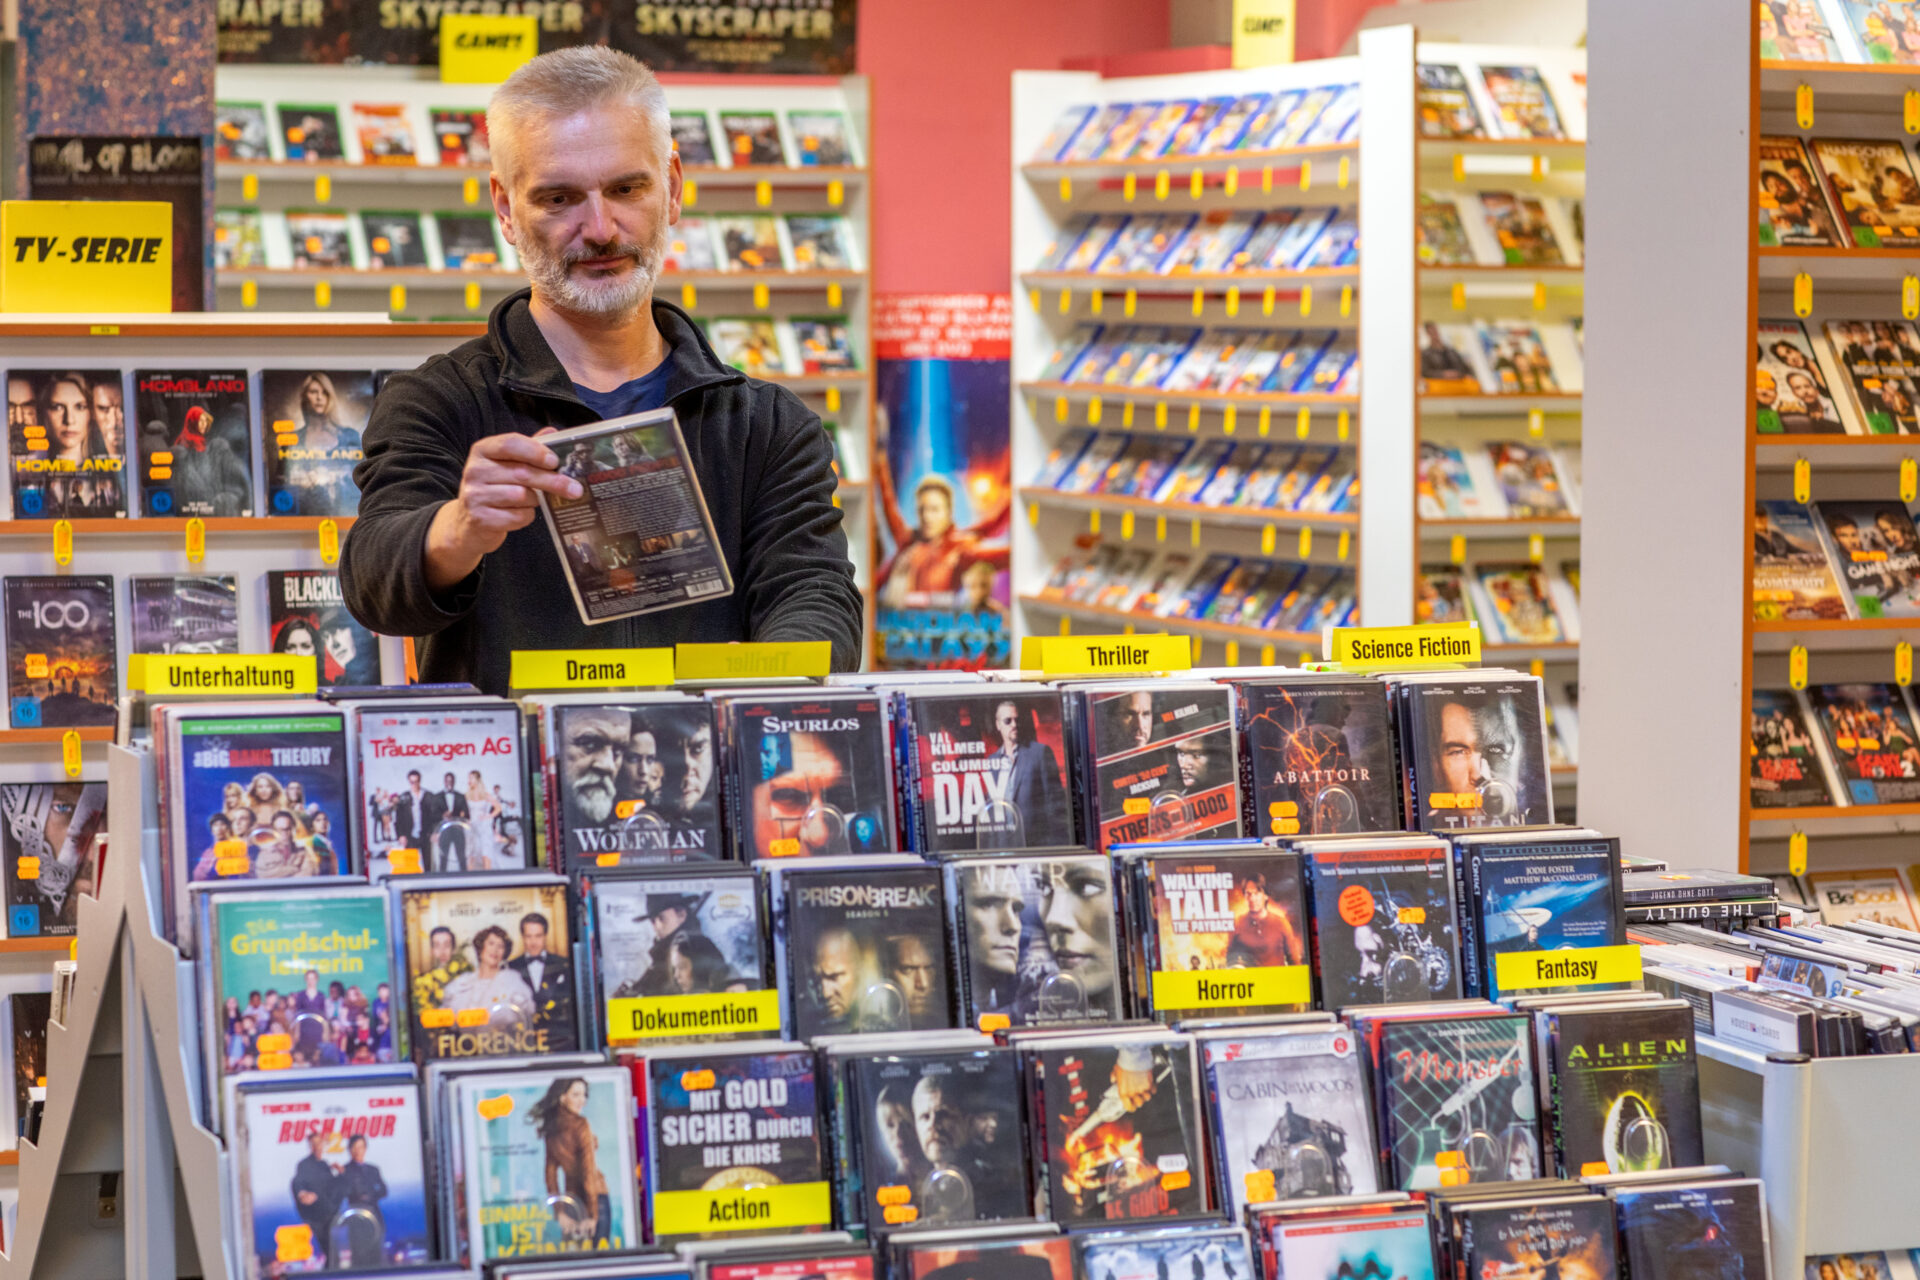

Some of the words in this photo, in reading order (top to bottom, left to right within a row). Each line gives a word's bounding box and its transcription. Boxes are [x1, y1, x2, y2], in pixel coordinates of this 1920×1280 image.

[635, 5, 834, 39] SKYSCRAPER
[14, 236, 163, 264] TV-SERIE
[140, 380, 245, 392] HOMELAND
[16, 458, 122, 473] HOMELAND
[278, 450, 364, 460] HOMELAND
[17, 610, 32, 620] THE
[32, 600, 90, 629] 100
[1086, 646, 1150, 666] Thriller
[1351, 638, 1414, 662] Science
[1418, 635, 1472, 659] Fiction
[169, 666, 295, 689] Unterhaltung
[566, 660, 626, 681] Drama
[762, 716, 861, 733] SPURLOS
[369, 738, 476, 761] Trauzeugen
[481, 736, 513, 756] AG
[929, 732, 950, 745] VAL
[930, 741, 986, 756] KILMER
[272, 746, 332, 767] THEORY
[931, 757, 1011, 773] COLUMBUS
[1273, 768, 1371, 784] ABATTOIR
[1899, 760, 1916, 778] 2
[933, 770, 1011, 827] DAY
[1181, 793, 1229, 826] BLOOD
[573, 828, 706, 852] WOLFMAN
[1471, 856, 1481, 896] CONTACT
[1503, 876, 1541, 885] MATTHEW
[1526, 866, 1547, 875] JODIE
[1548, 865, 1575, 874] FOSTER
[1161, 872, 1234, 890] WALKING
[1165, 889, 1234, 920] TALL
[1650, 889, 1676, 900] JUGEND
[1678, 888, 1695, 898] OHNE
[1697, 888, 1714, 897] GOTT
[845, 910, 880, 919] SEASON
[1645, 907, 1711, 921] GUILTY
[1720, 905, 1754, 917] THE
[1173, 921, 1189, 933] THE
[1191, 919, 1235, 932] PAYBACK
[230, 928, 379, 956] Grundschul-
[269, 952, 364, 976] lehrerin
[1536, 960, 1598, 980] Fantasy
[1197, 979, 1255, 1001] Horror
[632, 1003, 759, 1032] Dokumention
[438, 1028, 550, 1058] FLORENCE
[1568, 1038, 1687, 1060] ALIEN
[1397, 1050, 1524, 1084] Monster
[688, 1089, 721, 1112] MIT
[725, 1077, 789, 1110] GOLD
[1226, 1080, 1289, 1101] CABIN
[262, 1102, 312, 1115] TUCKER
[368, 1096, 405, 1108] CHAN
[278, 1117, 336, 1144] RUSH
[339, 1114, 397, 1140] HOUR
[661, 1112, 753, 1147] SICHER
[755, 1116, 813, 1140] DURCH
[326, 1132, 345, 1154] 2
[702, 1146, 730, 1168] DIE
[732, 1142, 782, 1166] KRISE
[479, 1205, 553, 1225] EINMAL
[708, 1197, 771, 1222] Action
[510, 1223, 546, 1244] IST
